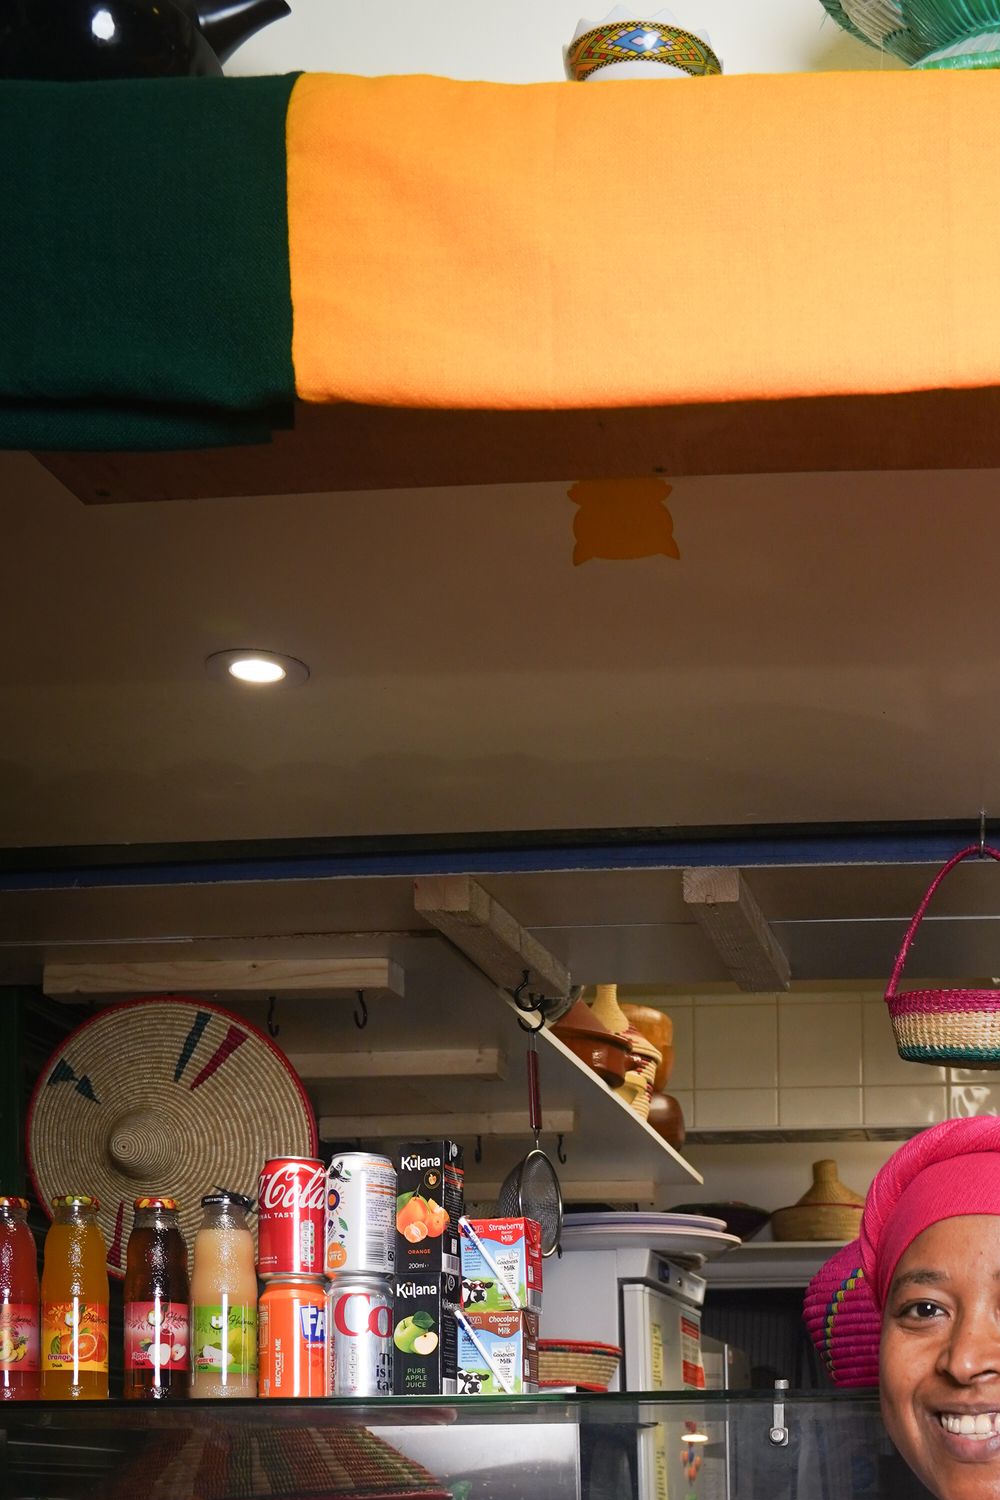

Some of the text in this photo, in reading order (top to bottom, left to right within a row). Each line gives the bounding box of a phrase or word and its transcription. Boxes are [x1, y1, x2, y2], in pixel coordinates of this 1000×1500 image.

[488, 1222, 524, 1232] Strawberry
[488, 1315, 519, 1323] Chocolate
[274, 1338, 282, 1388] RECYCLE ME
